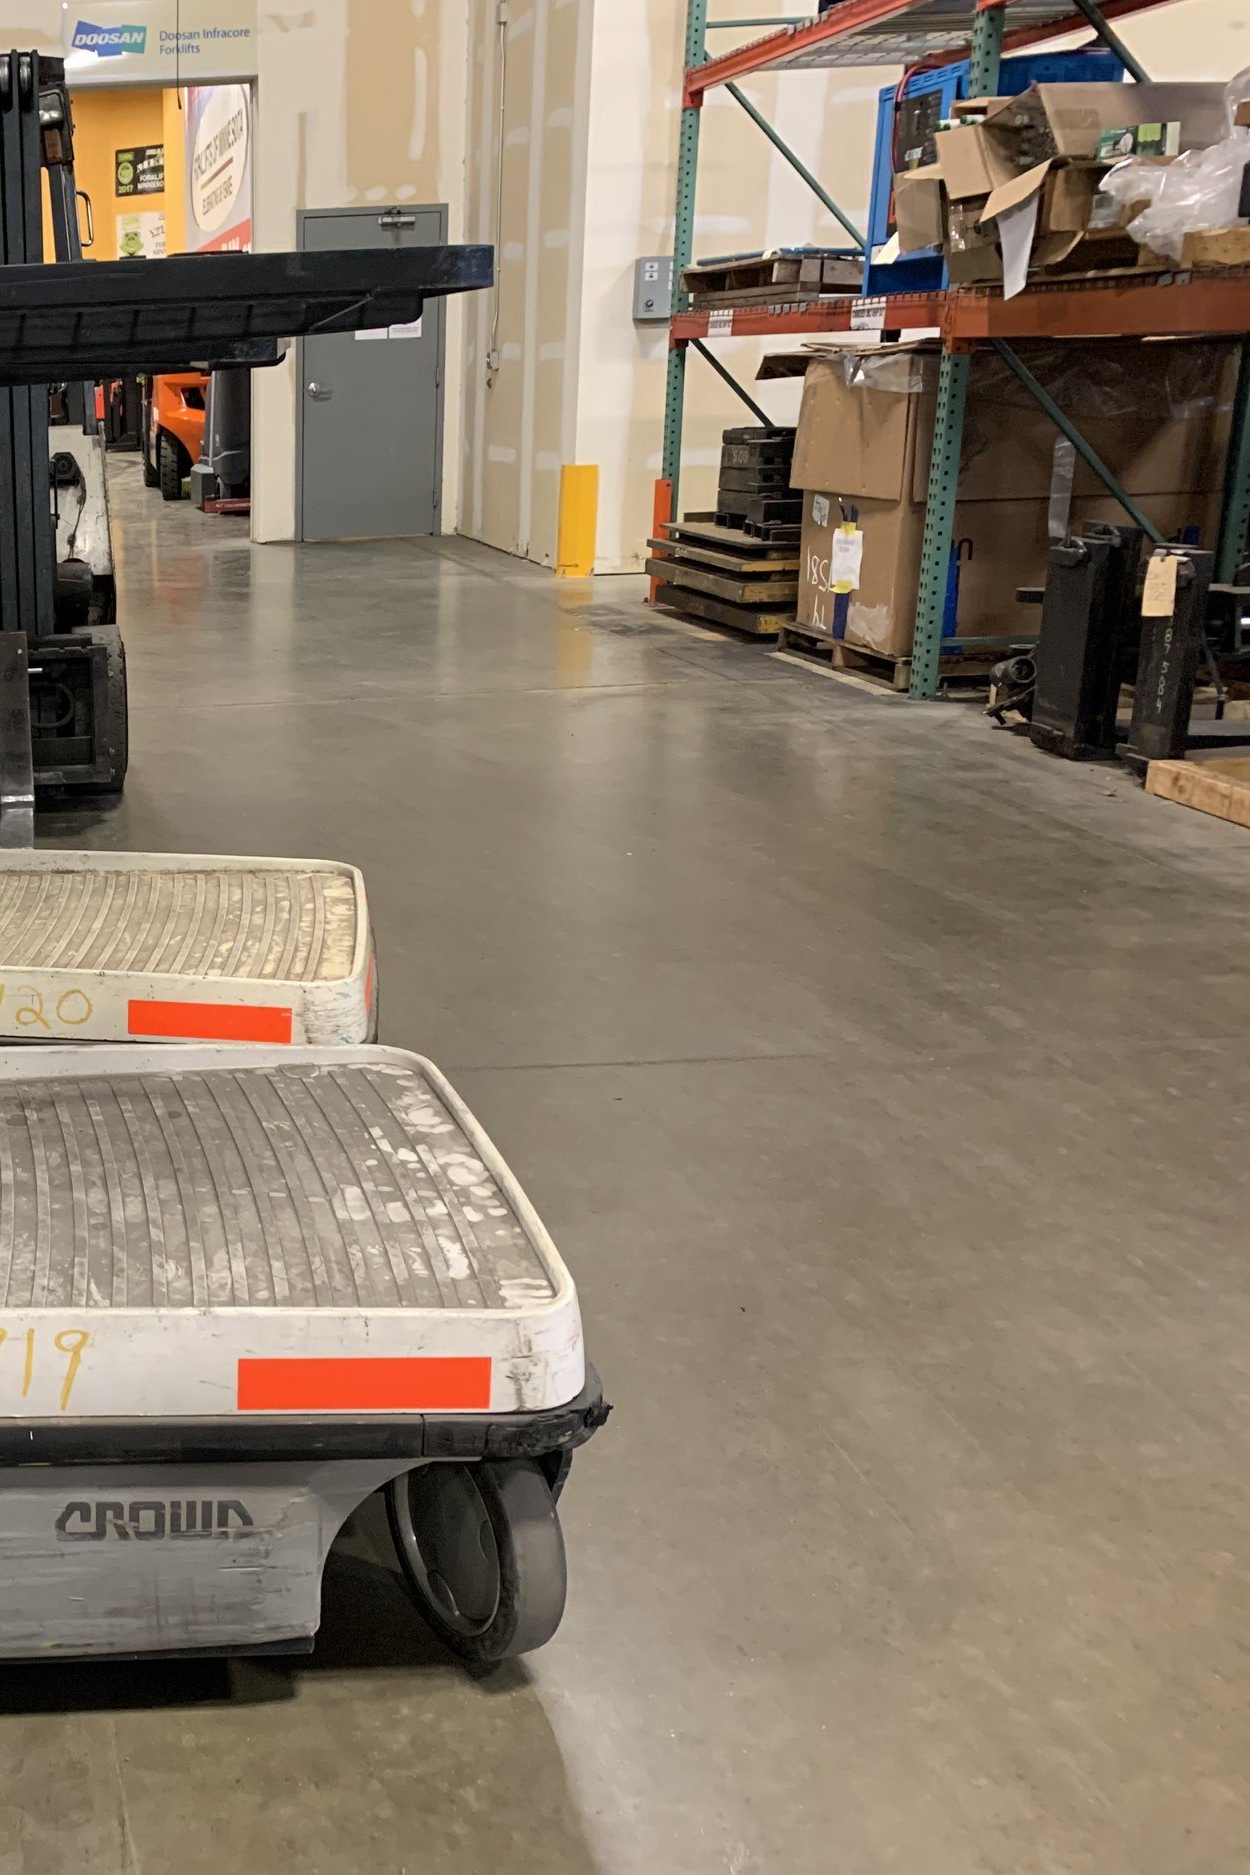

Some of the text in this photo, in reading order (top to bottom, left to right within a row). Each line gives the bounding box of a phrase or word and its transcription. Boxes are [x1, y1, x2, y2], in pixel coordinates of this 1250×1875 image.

[74, 31, 144, 46] DOOSAN
[159, 27, 251, 42] Doosan Infracore
[159, 43, 201, 55] Forklifts
[54, 1499, 255, 1542] CROWN
